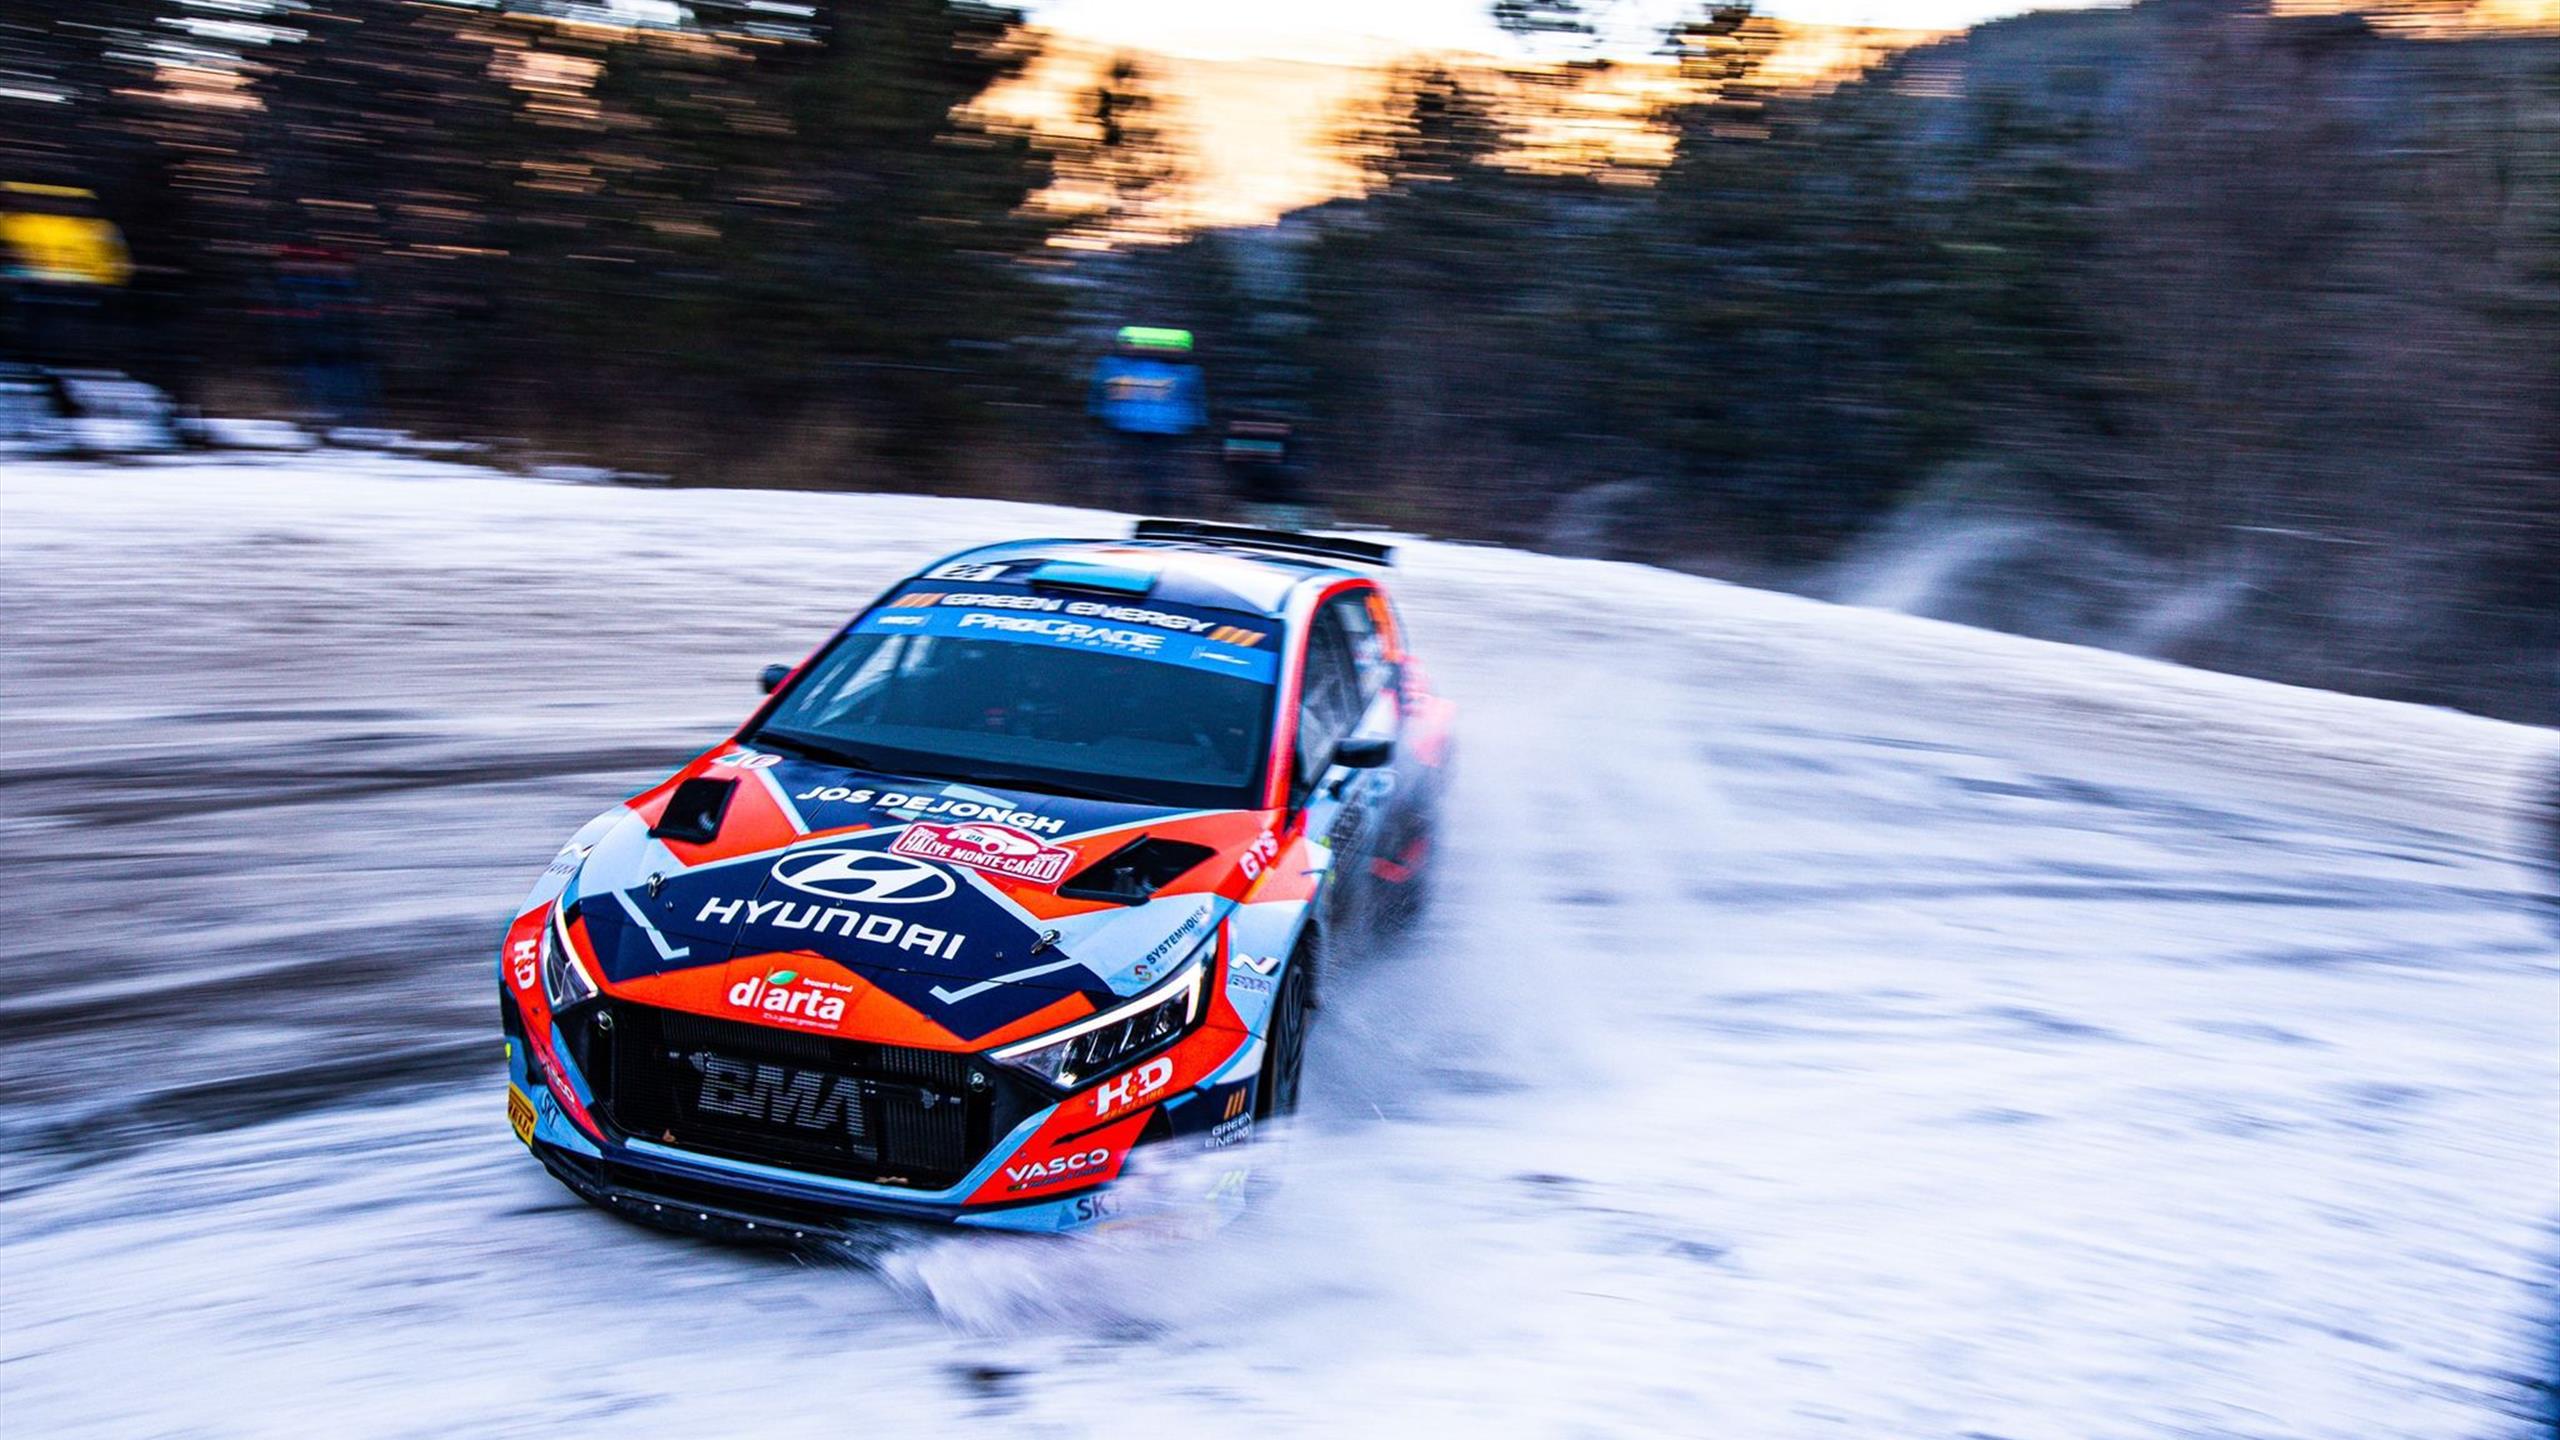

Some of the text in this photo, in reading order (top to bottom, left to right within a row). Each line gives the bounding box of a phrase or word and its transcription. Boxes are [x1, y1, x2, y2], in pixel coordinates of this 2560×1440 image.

[940, 593, 1216, 632] GREEN ENERGY
[796, 786, 877, 803] JOS
[875, 792, 1066, 834] DEJONGH
[900, 833, 952, 858] RALLYE
[950, 848, 1062, 880] MONTE-CARLO
[1239, 830, 1278, 881] GTS
[696, 898, 965, 960] HYUNDAI
[1146, 905, 1208, 965] SYSTEMHOUSE
[698, 1054, 866, 1137] BMA
[1006, 1148, 1109, 1182] VASCO
